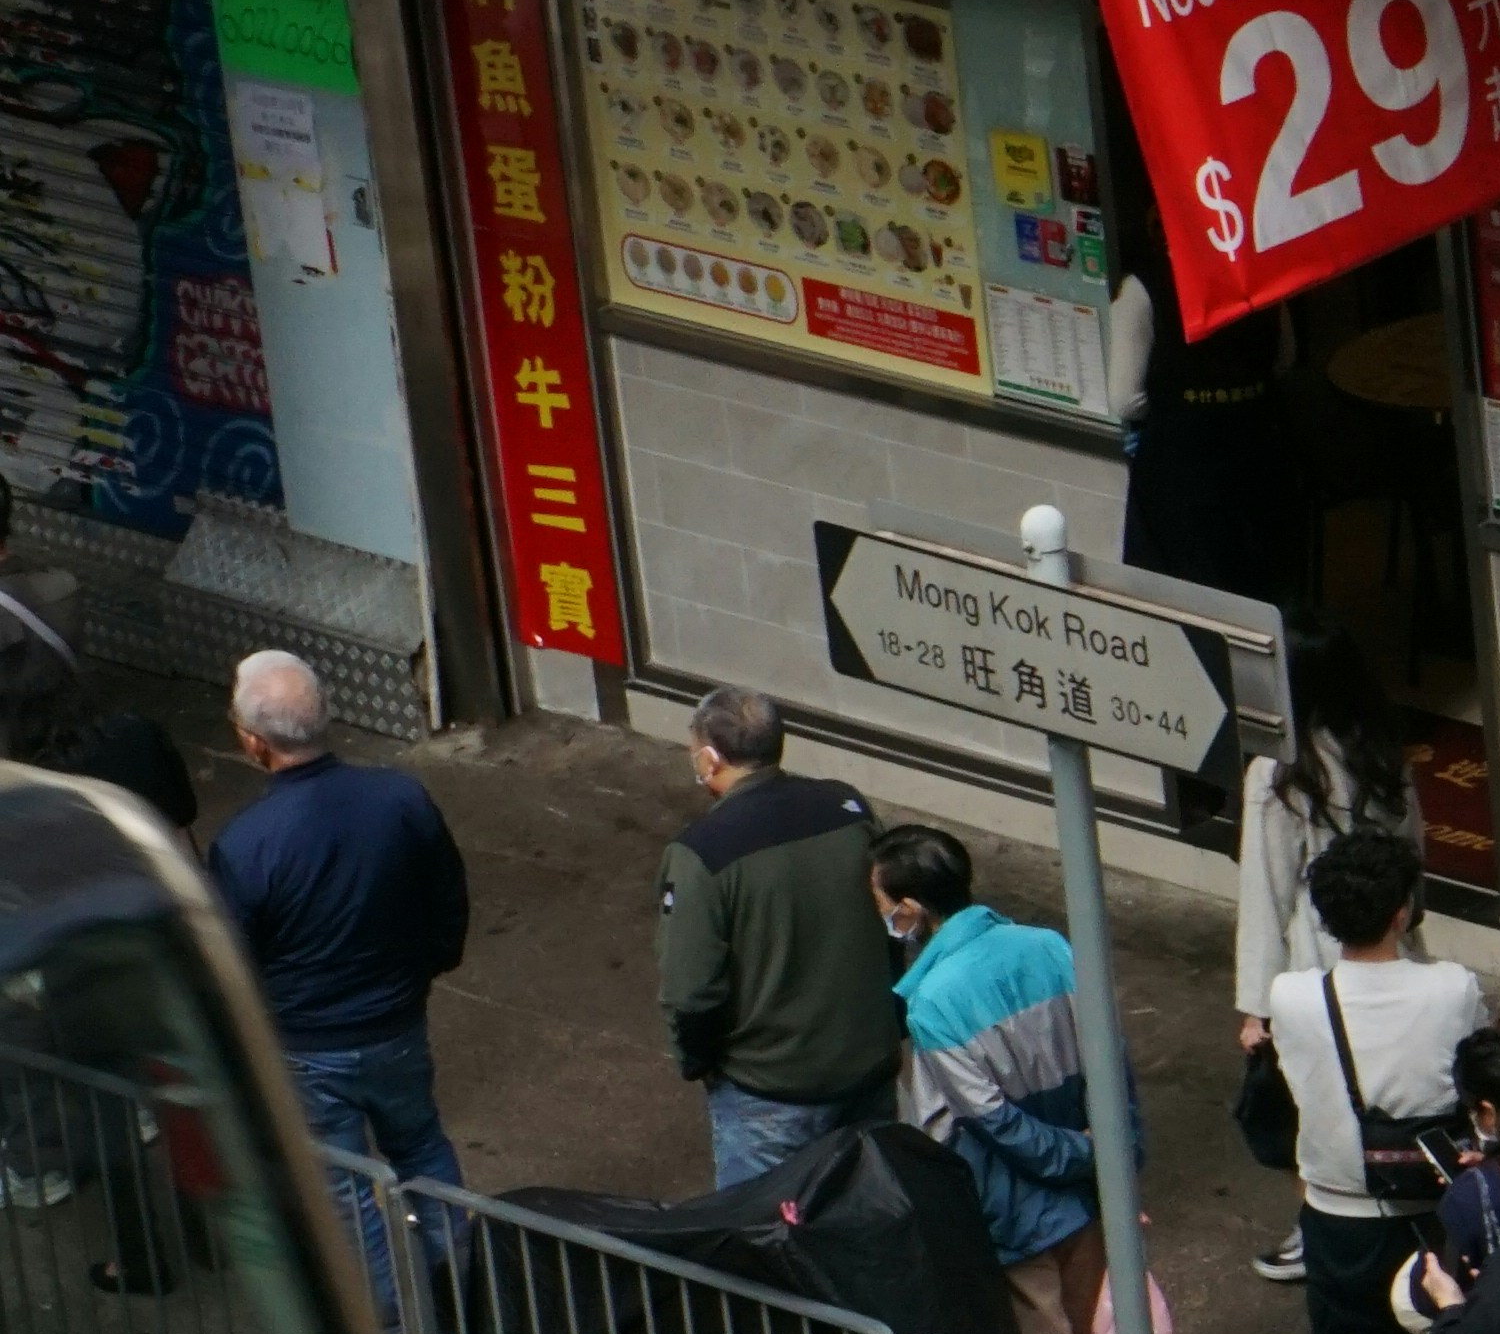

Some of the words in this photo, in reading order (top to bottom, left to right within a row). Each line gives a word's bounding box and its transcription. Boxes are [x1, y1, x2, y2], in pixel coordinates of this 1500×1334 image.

[895, 565, 980, 627] Mong
[989, 591, 1053, 642] Kok
[1065, 611, 1151, 668] Road
[879, 628, 946, 669] 18-28
[961, 645, 1099, 727] 旺角道
[1110, 696, 1189, 740] 30-44
